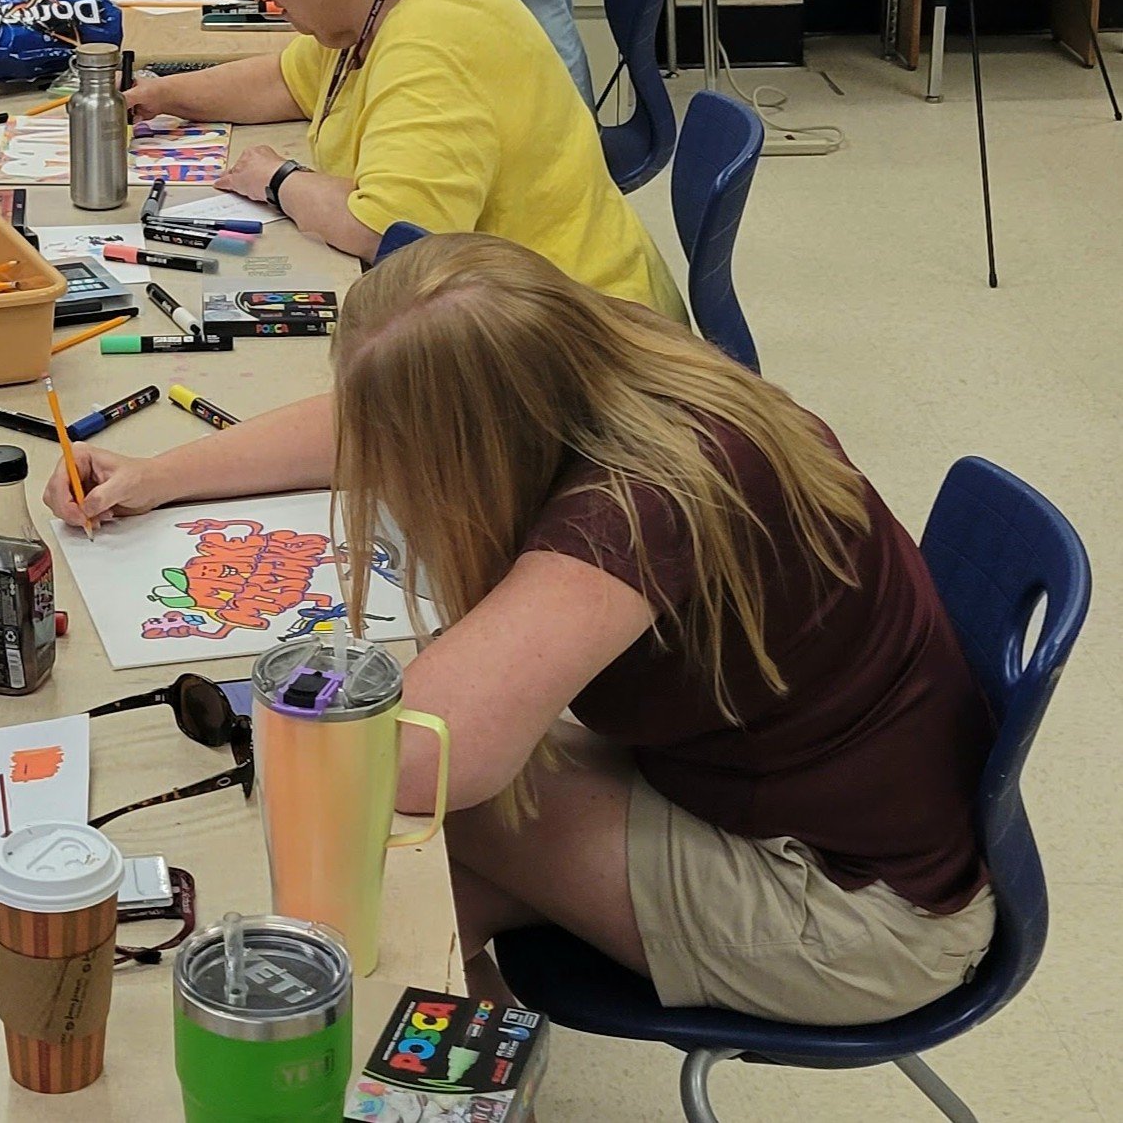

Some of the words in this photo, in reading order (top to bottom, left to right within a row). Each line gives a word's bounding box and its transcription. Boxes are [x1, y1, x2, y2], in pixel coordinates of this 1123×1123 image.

[251, 292, 327, 304] POSCA
[256, 323, 290, 334] POSCA
[388, 1001, 459, 1074] POSCA
